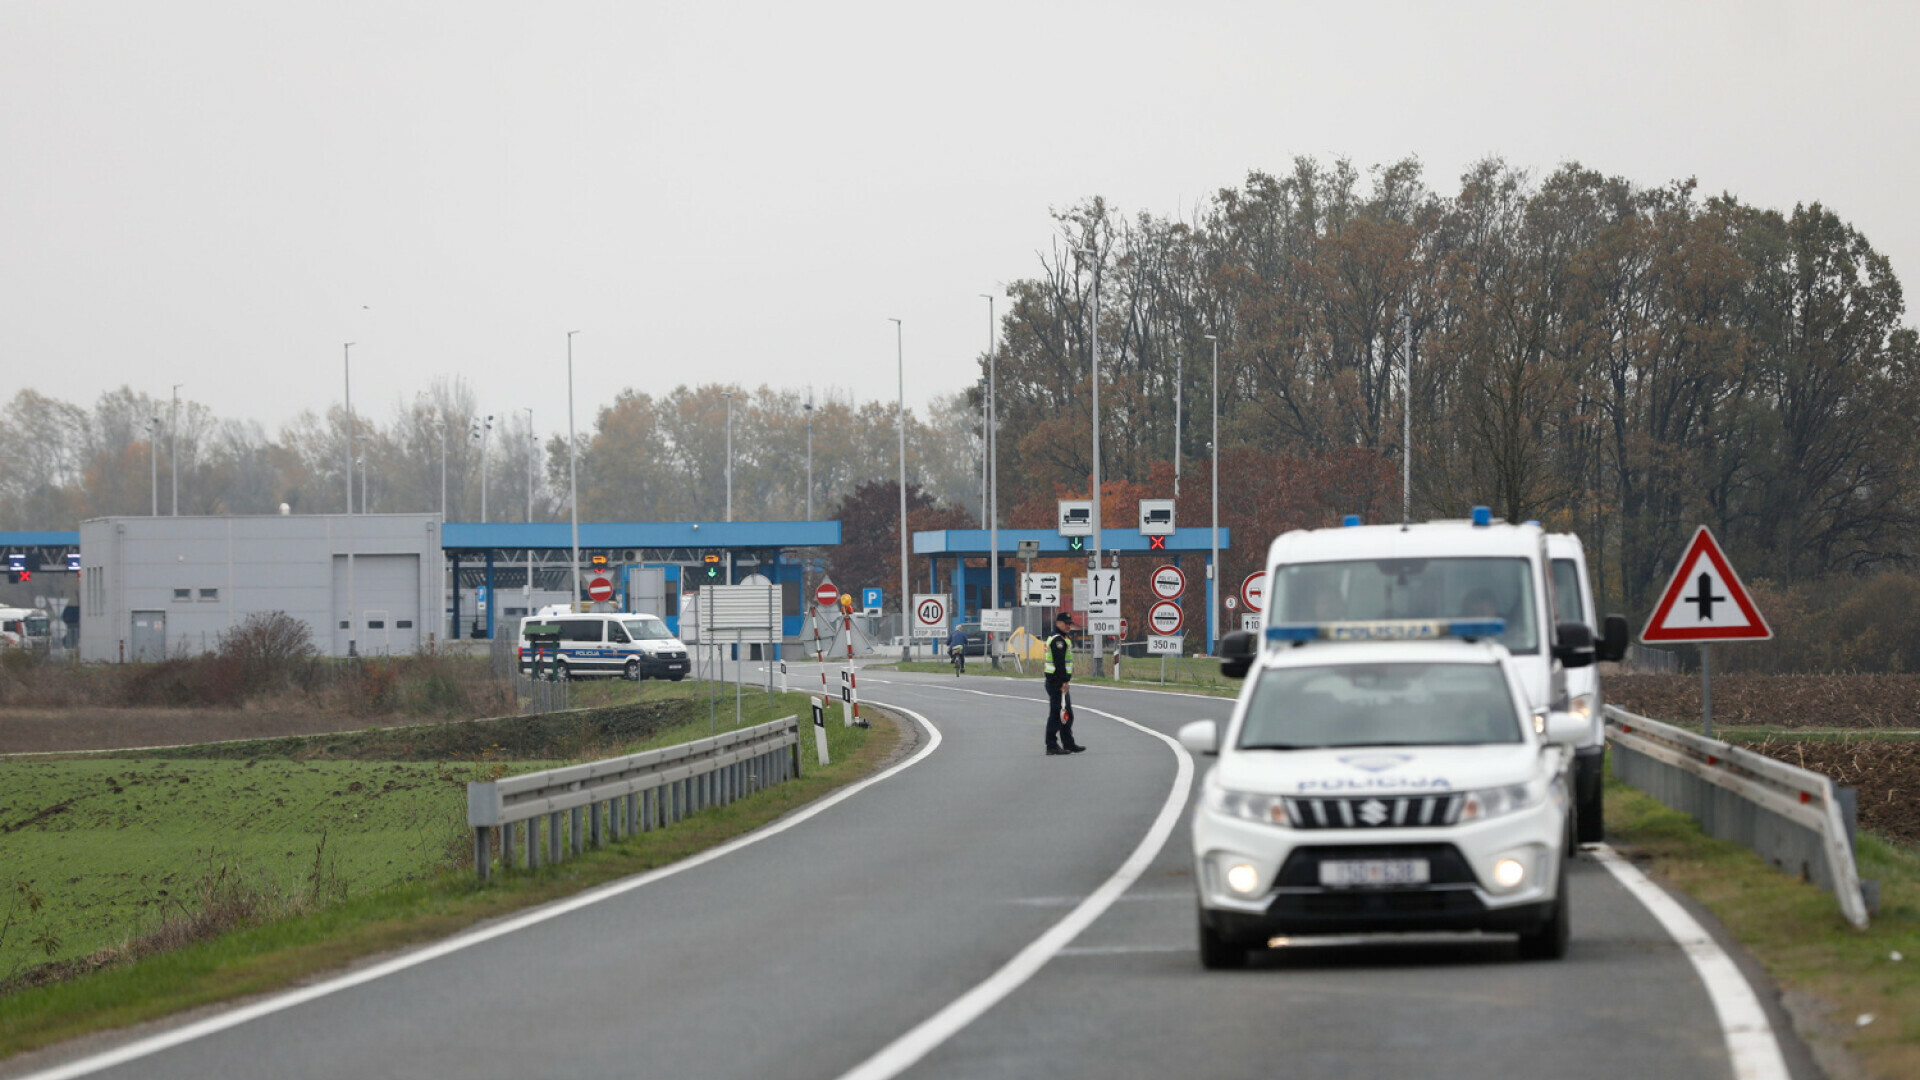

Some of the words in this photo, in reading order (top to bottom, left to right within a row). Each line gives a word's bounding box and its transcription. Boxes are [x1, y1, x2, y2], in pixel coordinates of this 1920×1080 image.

[868, 592, 877, 605] P
[923, 605, 939, 619] 40
[1094, 622, 1107, 631] 100
[1336, 625, 1433, 638] POLICIJA
[1153, 640, 1168, 649] 350
[1298, 777, 1453, 792] POLICIJA
